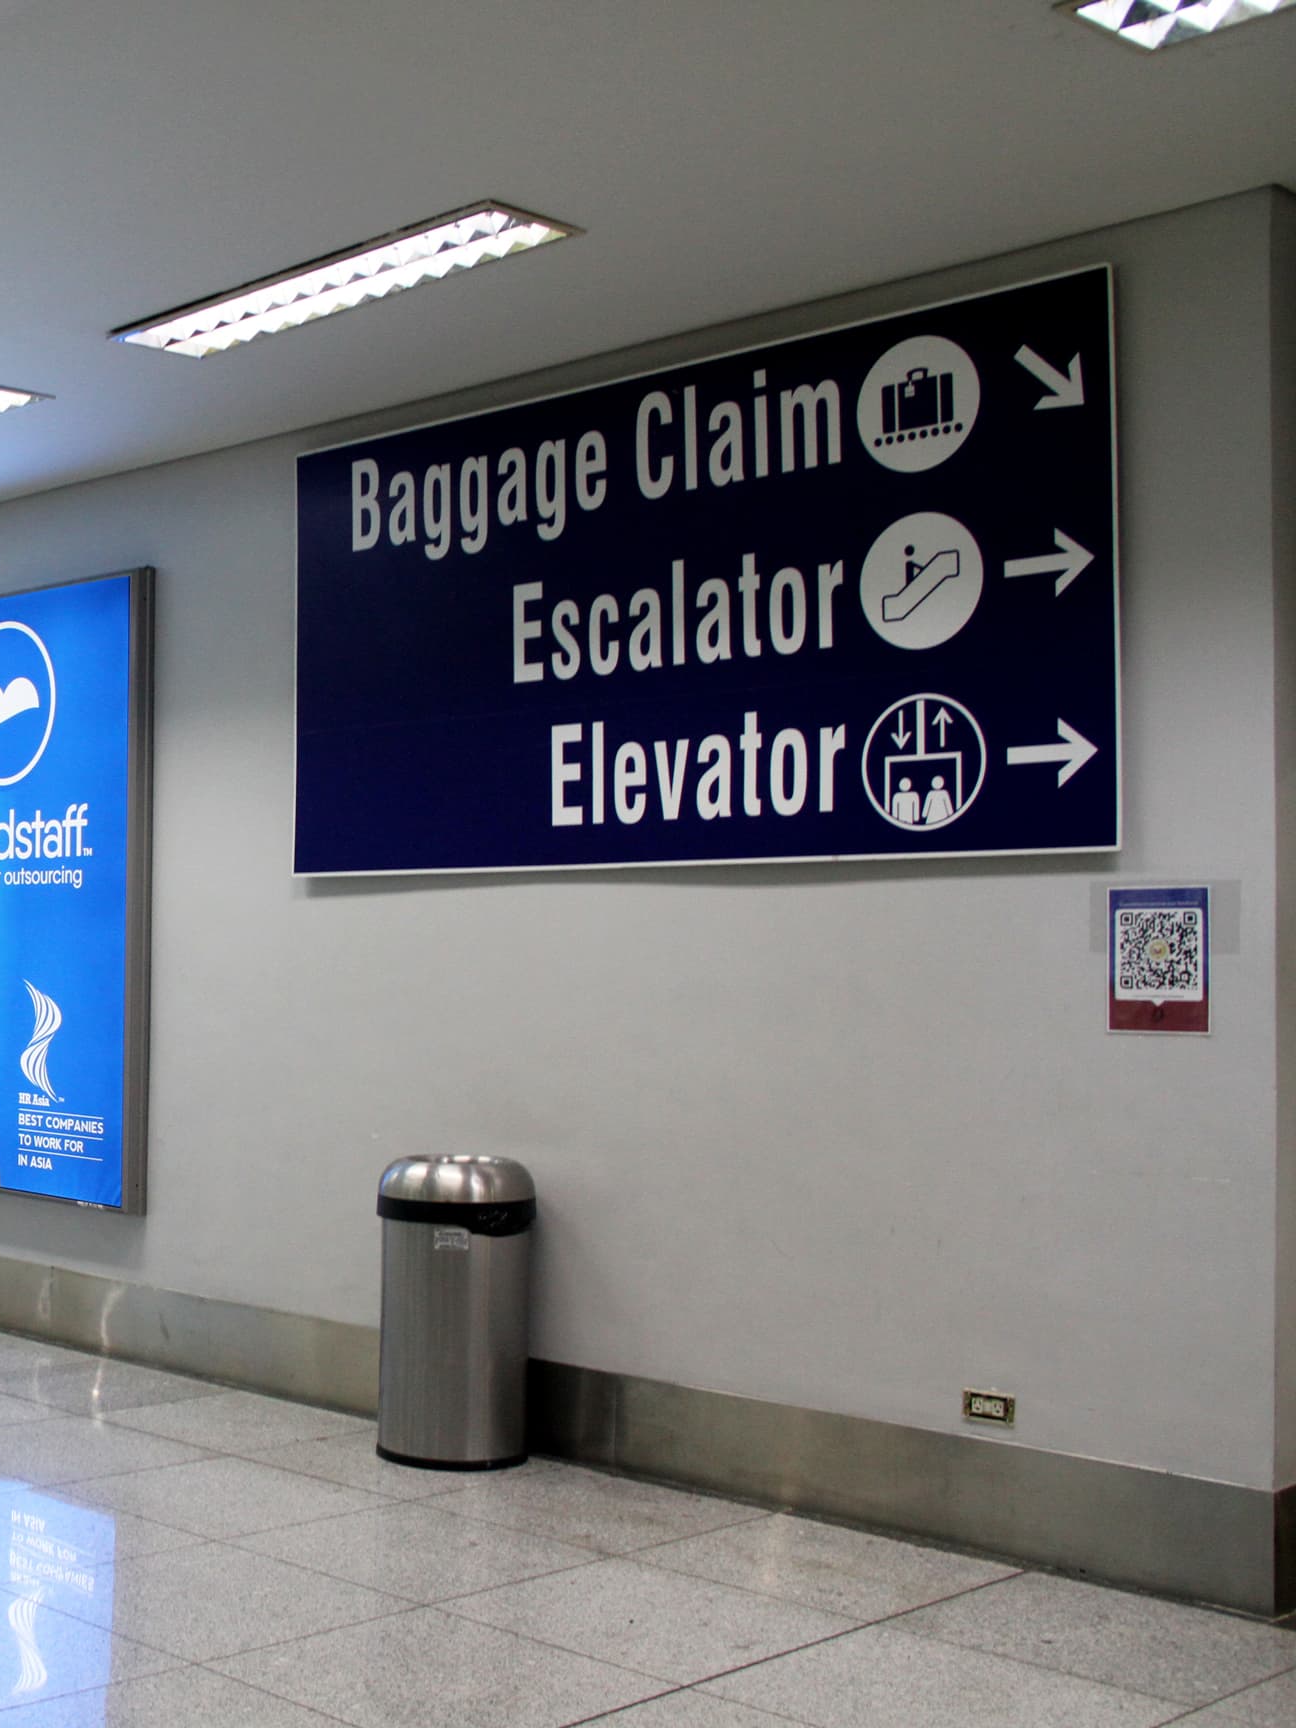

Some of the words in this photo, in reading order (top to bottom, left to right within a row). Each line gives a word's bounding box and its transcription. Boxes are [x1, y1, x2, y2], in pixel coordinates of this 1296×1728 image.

[351, 427, 608, 561] Baggage
[635, 368, 843, 500] Claim
[512, 552, 844, 684] Escalator
[550, 711, 845, 827] Elevator
[5, 865, 83, 889] outsourcing
[18, 1092, 31, 1105] HR
[32, 1093, 50, 1107] Asia
[18, 1113, 43, 1127] BEST
[46, 1116, 104, 1134] COMPANIES
[18, 1133, 32, 1146] TO
[34, 1135, 62, 1150] WORK
[64, 1139, 84, 1152] FOR
[17, 1154, 28, 1166] IN
[30, 1156, 53, 1170] ASIA
